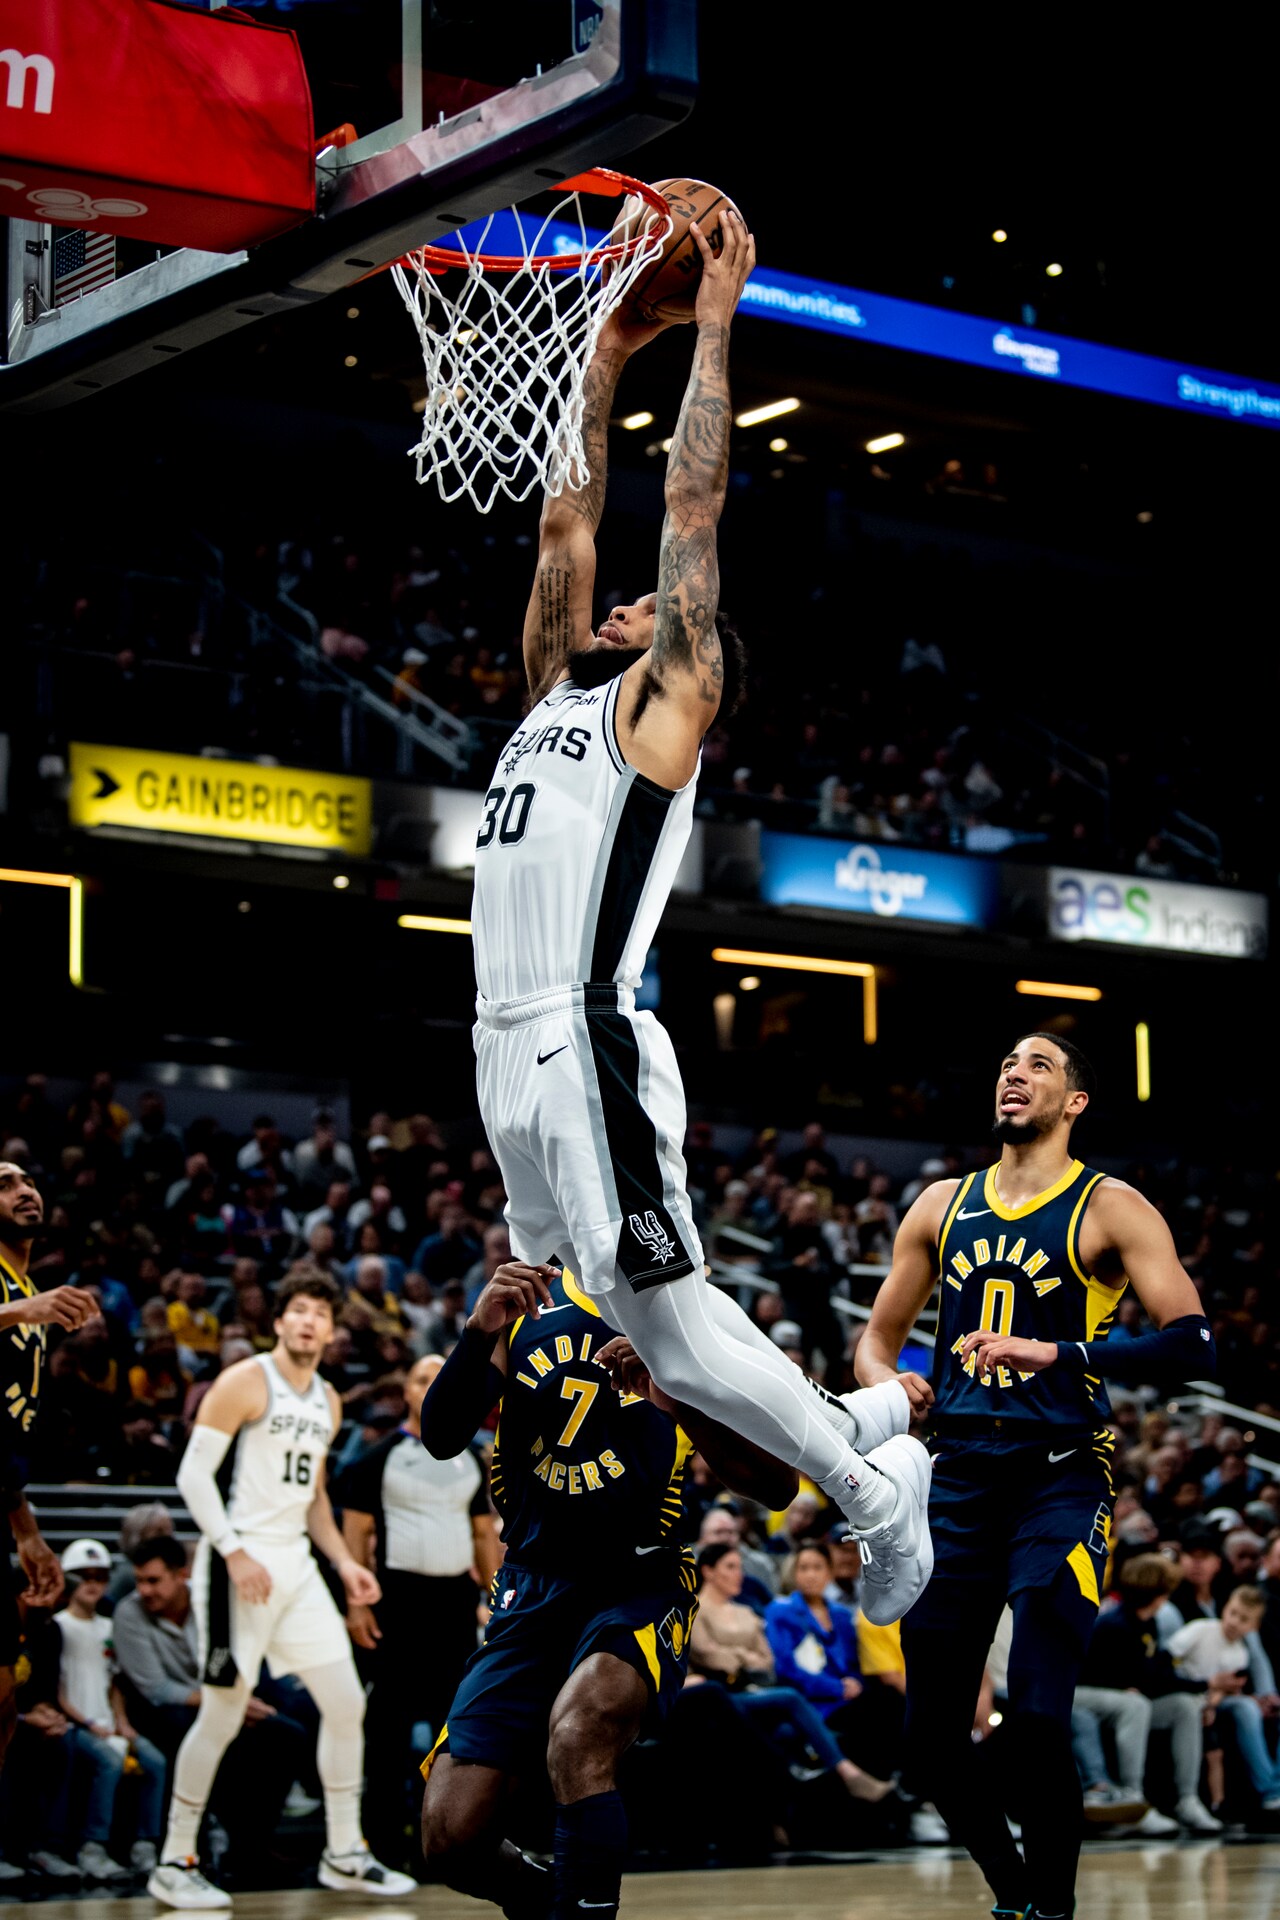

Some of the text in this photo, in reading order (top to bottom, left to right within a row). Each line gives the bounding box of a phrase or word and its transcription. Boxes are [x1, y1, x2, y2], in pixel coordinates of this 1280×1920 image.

[576, 694, 600, 706] elf
[500, 726, 592, 775] PURS
[135, 769, 355, 837] GAINBRIDGE
[476, 782, 537, 850] 30
[835, 844, 928, 917] Kroger
[1055, 878, 1152, 942] aes
[945, 1234, 1062, 1298] INDIANA
[980, 1278, 1015, 1337] 0
[516, 1333, 645, 1407] INDIA
[557, 1376, 600, 1447] 7
[282, 1450, 312, 1486] 16
[530, 1435, 626, 1495] PACERS
